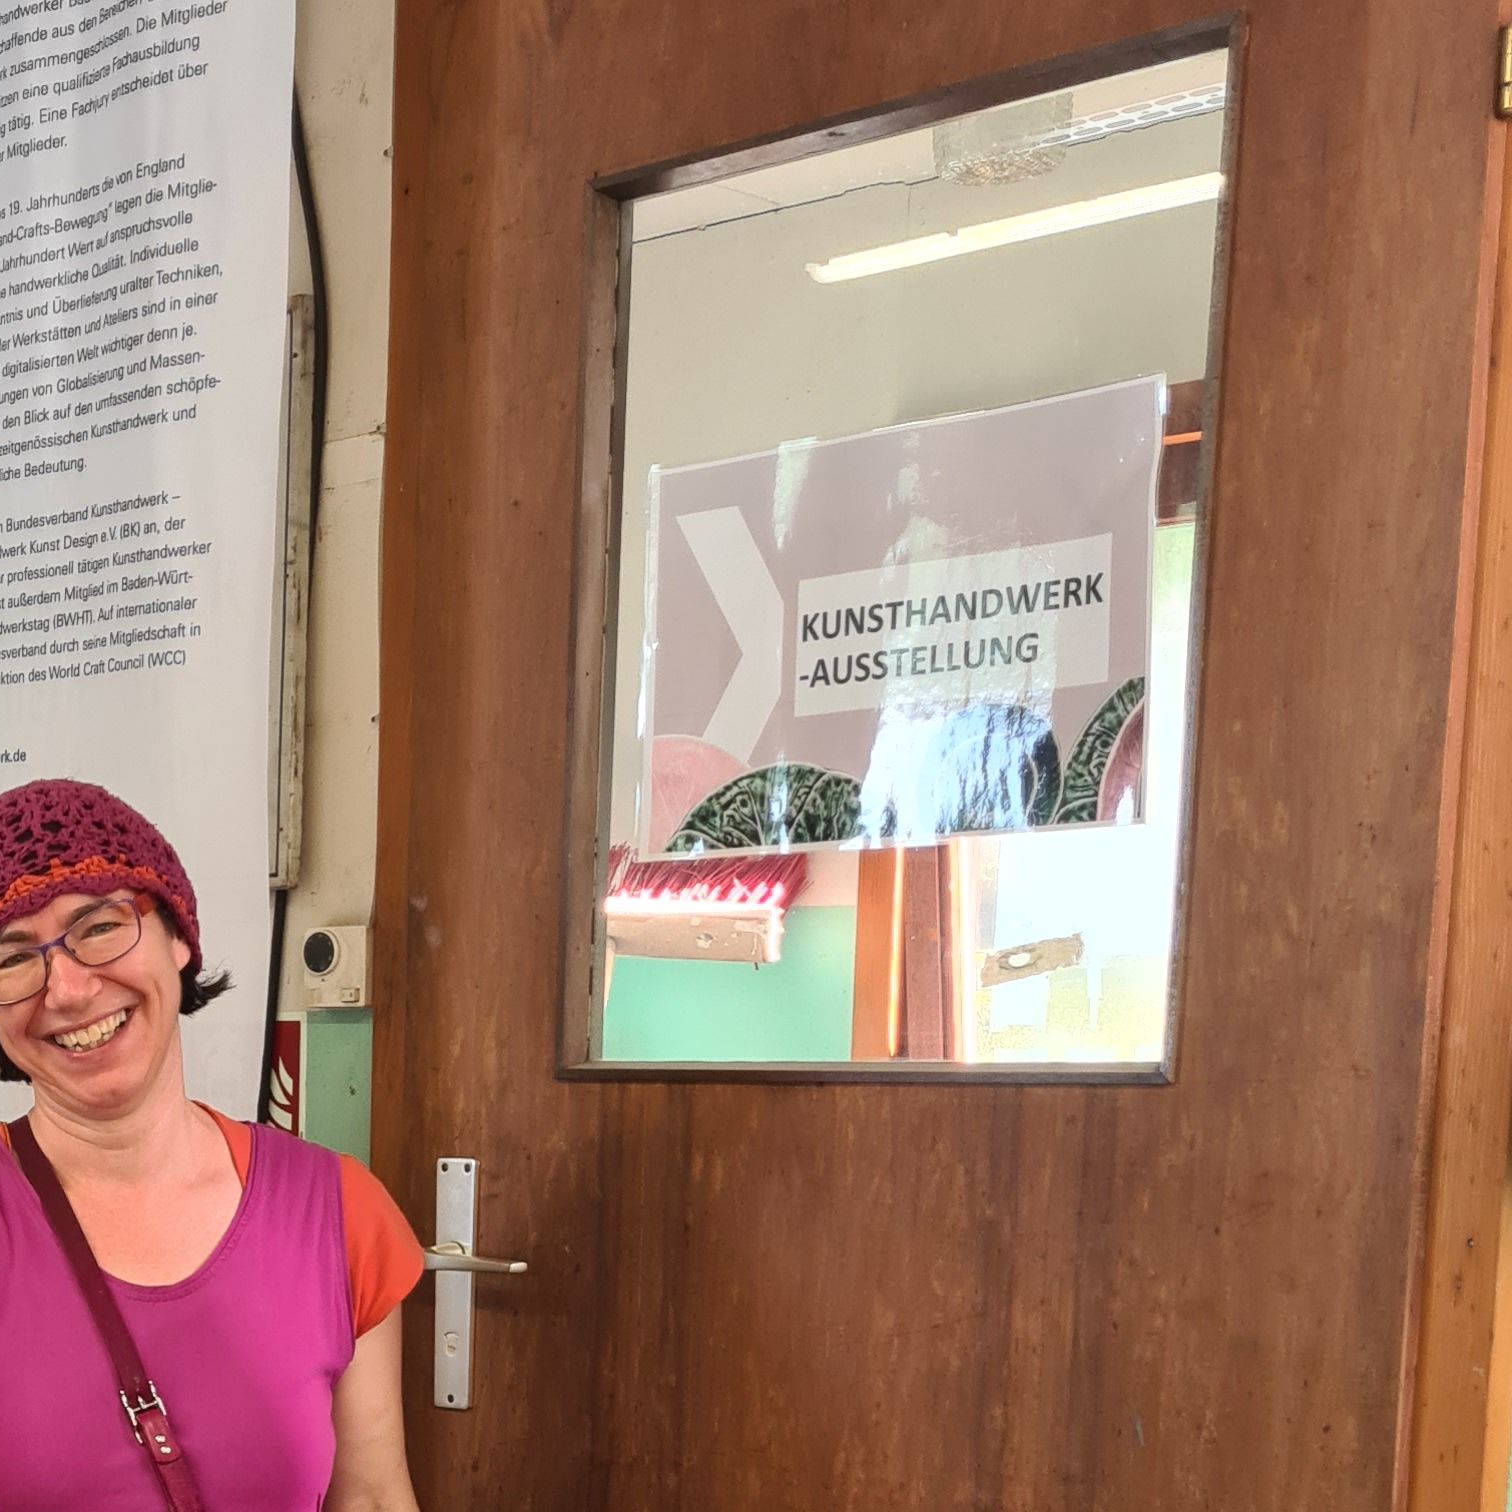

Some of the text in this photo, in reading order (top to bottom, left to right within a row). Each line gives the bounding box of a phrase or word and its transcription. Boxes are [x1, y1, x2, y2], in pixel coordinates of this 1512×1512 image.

[52, 24, 74, 38] aus
[137, 17, 156, 33] Die
[161, 1, 227, 27] Mitglieder
[23, 84, 48, 100] eine
[113, 36, 200, 72] Fachausbildung
[40, 107, 67, 123] Eine
[72, 93, 108, 118] Fachjury
[112, 69, 173, 100] entscheidet
[178, 62, 208, 79] über
[7, 134, 67, 159] Mitglieder.
[26, 184, 100, 212] Jahrhunderts
[116, 169, 133, 185] von
[136, 153, 185, 179] England
[115, 195, 142, 214] legen
[145, 188, 163, 204] die
[168, 177, 217, 200] Mitglie-
[0, 246, 65, 273] Jahrhundert
[68, 239, 94, 258] Wert
[110, 210, 192, 243] anspruchsvolle
[9, 268, 88, 297] handwerkliche
[130, 237, 199, 265] Individuelle
[27, 302, 48, 319] und
[53, 286, 117, 314] Überlieferung
[120, 276, 154, 295] uralter
[156, 263, 223, 286] Techniken,
[13, 323, 81, 348] Werkstätten
[103, 307, 138, 328] Ateliers
[142, 297, 165, 317] sind
[185, 292, 218, 309] einer
[2, 351, 74, 379] digitalisierten
[101, 333, 144, 355] wichtiger
[147, 326, 178, 343] denn
[32, 384, 52, 397] von
[57, 365, 124, 393] Globalisierung
[127, 358, 146, 375] und
[150, 351, 205, 371] Massen-
[3, 415, 21, 430] den
[24, 407, 49, 426] Blick
[53, 403, 70, 420] auf
[96, 384, 162, 411] umfassenden
[166, 374, 221, 396] schöpfe-
[91, 408, 168, 439] Kunsthandwerk
[172, 404, 196, 421] und
[24, 457, 87, 478] Bedeutung.
[6, 506, 88, 533] Bundesverband
[91, 490, 168, 517] Kunsthandwerk
[29, 538, 60, 555] Kunst
[63, 533, 98, 550] Design
[120, 521, 140, 540] (BK)
[165, 516, 185, 531] der
[7, 560, 73, 587] professionell
[78, 556, 109, 573] tätigen
[113, 541, 212, 566] Kunsthandwerker
[8, 570, 192, 609] außerdem Mitglied Baden-Würt-
[98, 605, 113, 621] Auf
[116, 597, 197, 618] internationaler
[801, 572, 1105, 643] KUNSTHANDWERK
[50, 637, 78, 654] durch
[83, 636, 107, 650] seine
[110, 622, 186, 645] Mitgliedschaft
[799, 632, 1039, 688] -AUSSTELLUNG
[29, 667, 46, 682] des
[49, 662, 80, 679] World
[84, 659, 105, 676] Craft
[108, 655, 144, 673] Council
[148, 650, 186, 667] (WCC)
